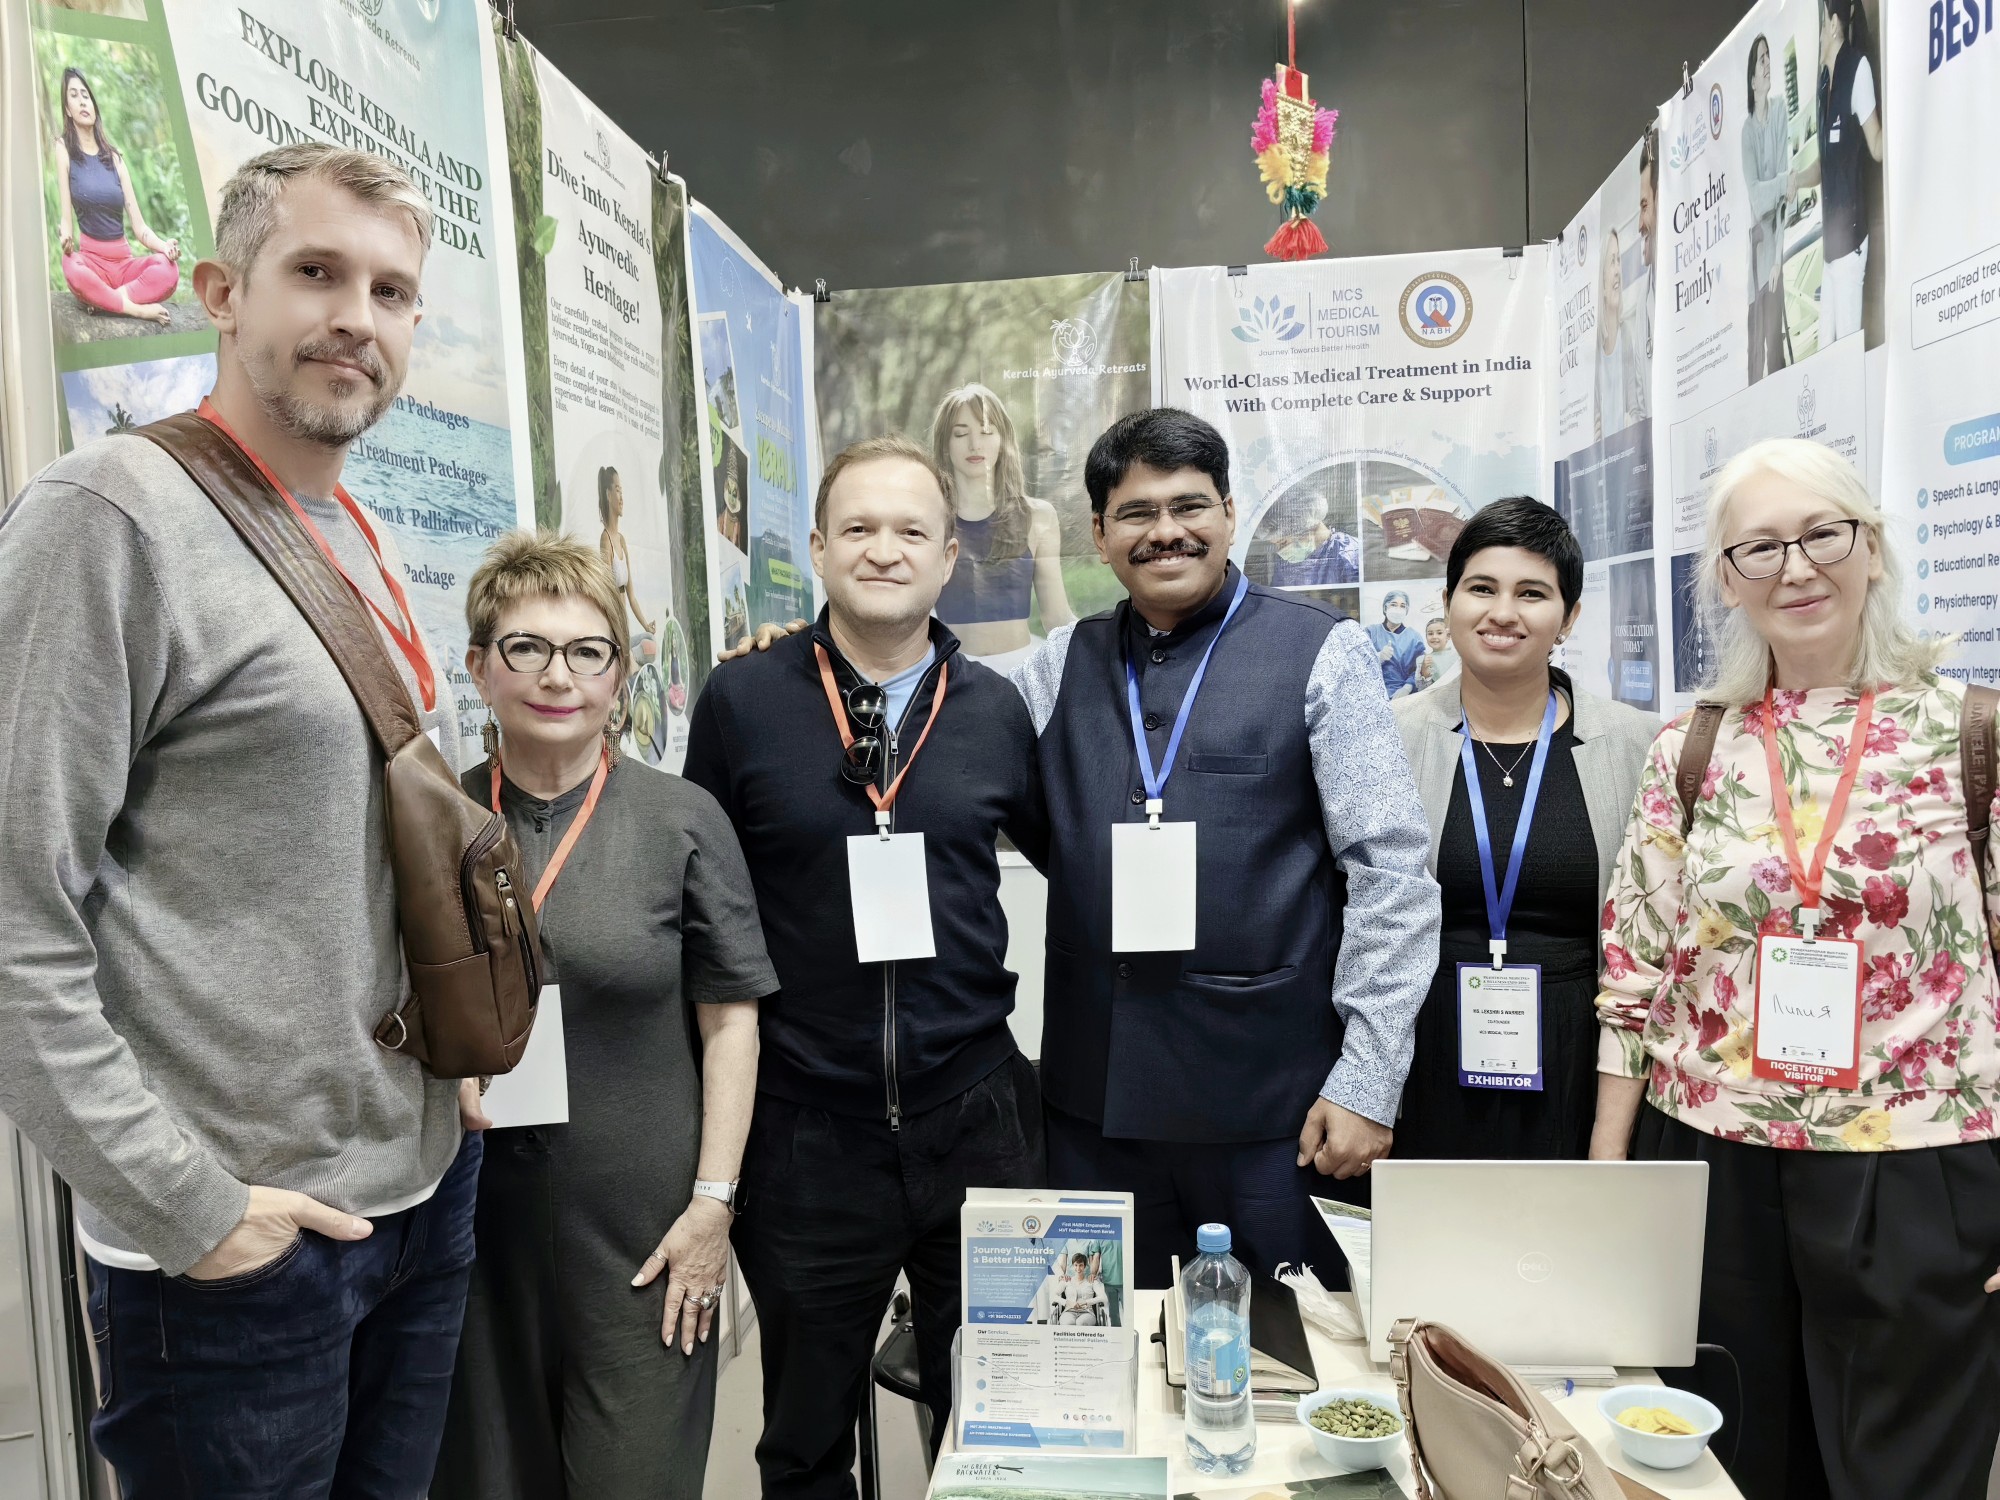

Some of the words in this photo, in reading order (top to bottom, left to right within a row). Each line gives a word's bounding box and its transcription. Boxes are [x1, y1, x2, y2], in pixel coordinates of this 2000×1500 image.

[385, 29, 420, 72] Retreats
[238, 8, 355, 115] EXPLORE
[358, 92, 433, 169] KERALA
[435, 151, 483, 193] AND
[434, 181, 481, 226] THE
[547, 148, 579, 195] Dive
[582, 175, 611, 217] into
[613, 199, 651, 255] Kerala's
[1673, 197, 1701, 234] Care
[1704, 171, 1727, 211] that
[578, 219, 640, 283] Ayurvedic
[1674, 225, 1702, 275] Feels
[1706, 206, 1731, 251] Like
[583, 265, 640, 324] Heritage!
[1332, 288, 1363, 302] MCS
[1675, 258, 1715, 313] Family
[1915, 267, 1979, 307] Personalized
[551, 297, 561, 310] Our
[564, 305, 590, 325] carefully
[1318, 306, 1380, 321] MEDICAL
[1938, 294, 1978, 323] support
[1981, 289, 1995, 306] for
[551, 310, 571, 330] holistic
[573, 323, 599, 341] remedies
[1317, 324, 1380, 339] TOURISM
[1421, 327, 1451, 336] NABH
[552, 326, 579, 349] Ayurveda,
[580, 338, 596, 356] Yoga,
[597, 347, 607, 358] and
[1258, 348, 1289, 357] Journey
[1290, 346, 1320, 355] Towards
[1321, 344, 1343, 353] Better
[1345, 342, 1370, 351] Health
[553, 354, 568, 372] Every
[570, 362, 586, 378] detail
[588, 370, 594, 380] of
[596, 374, 609, 386] your
[1003, 368, 1040, 380] Kerala
[1042, 365, 1096, 381] Ayurveda
[1100, 362, 1147, 375] Retreats
[1184, 373, 1289, 391] World-Class
[1292, 367, 1362, 385] Medical
[1365, 362, 1458, 380] Treatment
[1463, 359, 1480, 374] in
[1485, 356, 1532, 372] India
[554, 371, 572, 386] ensure
[573, 380, 598, 396] complete
[555, 386, 583, 404] experience
[584, 395, 596, 409] that
[598, 399, 616, 416] leaves
[555, 397, 569, 413] bliss.
[1225, 398, 1266, 413] With
[1271, 393, 1353, 412] Complete
[1357, 391, 1398, 405] Care
[1402, 388, 1416, 402] &
[1420, 384, 1493, 403] Support
[407, 394, 470, 430] Packages
[1834, 434, 1856, 447] through
[1845, 446, 1857, 457] and
[359, 437, 427, 473] Treatment
[428, 456, 488, 488] Packages
[756, 432, 798, 498] KERALA
[1932, 484, 1965, 506] Speech
[1967, 482, 1973, 496] &
[396, 505, 407, 526] &
[411, 508, 473, 536] Palliative
[475, 519, 503, 539] Care
[1933, 518, 1983, 540] Psychology
[1985, 515, 1993, 529] &
[1933, 553, 1986, 573] Educational
[404, 563, 456, 590] Package
[1934, 593, 1998, 613] Physiotherapy
[1935, 666, 1971, 682] Sensory
[458, 695, 485, 711] about
[460, 721, 478, 738] last
[1467, 1074, 1532, 1087] EXHIBITOR
[1770, 1061, 1839, 1077] ПОСЕТИТЕЛЬ
[1784, 1071, 1825, 1083] VISITOR
[973, 1246, 1012, 1256] Journey
[1014, 1246, 1055, 1255] Towards
[981, 1255, 1013, 1264] Better
[1014, 1256, 1046, 1264] Health
[1521, 1263, 1549, 1272] DELL
